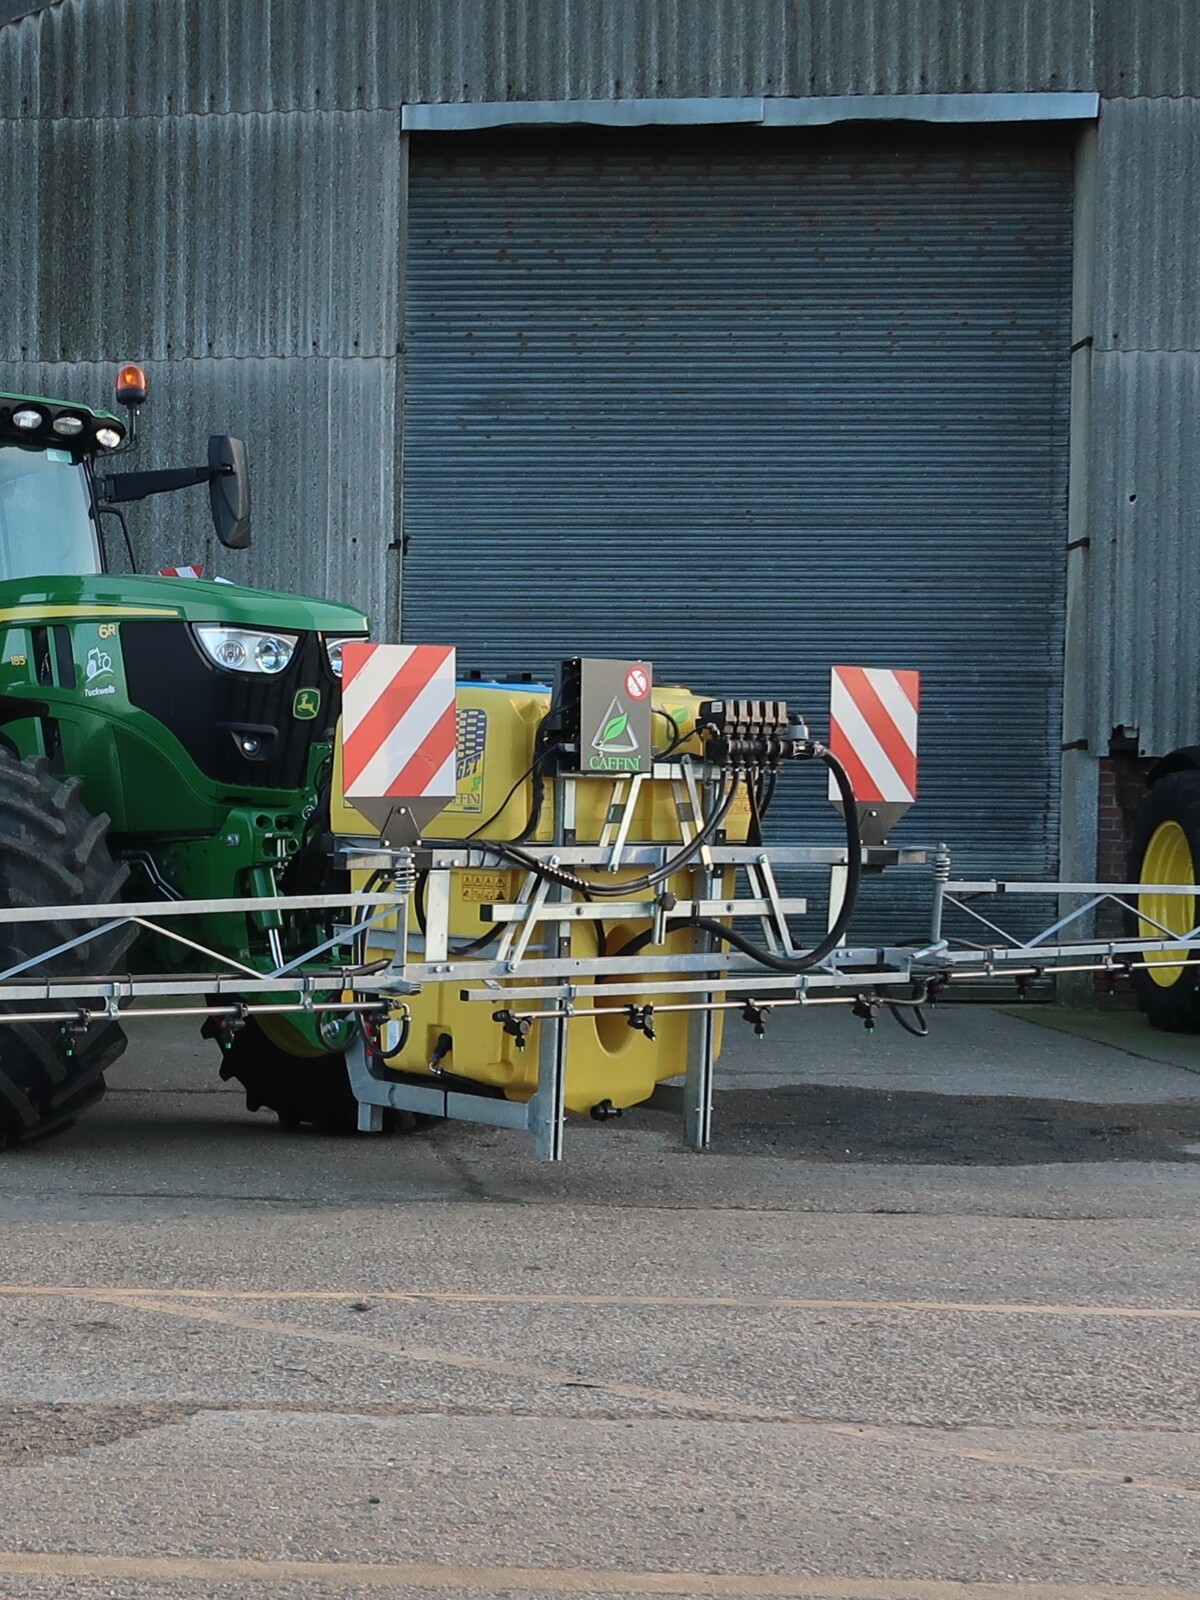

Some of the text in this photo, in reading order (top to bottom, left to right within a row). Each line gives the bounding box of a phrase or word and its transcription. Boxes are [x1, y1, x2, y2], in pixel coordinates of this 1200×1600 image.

[97, 623, 117, 640] 6R
[10, 655, 26, 667] 185
[84, 684, 116, 698] Tuckwells
[456, 754, 481, 781] GET
[589, 755, 640, 770] CAFFINI
